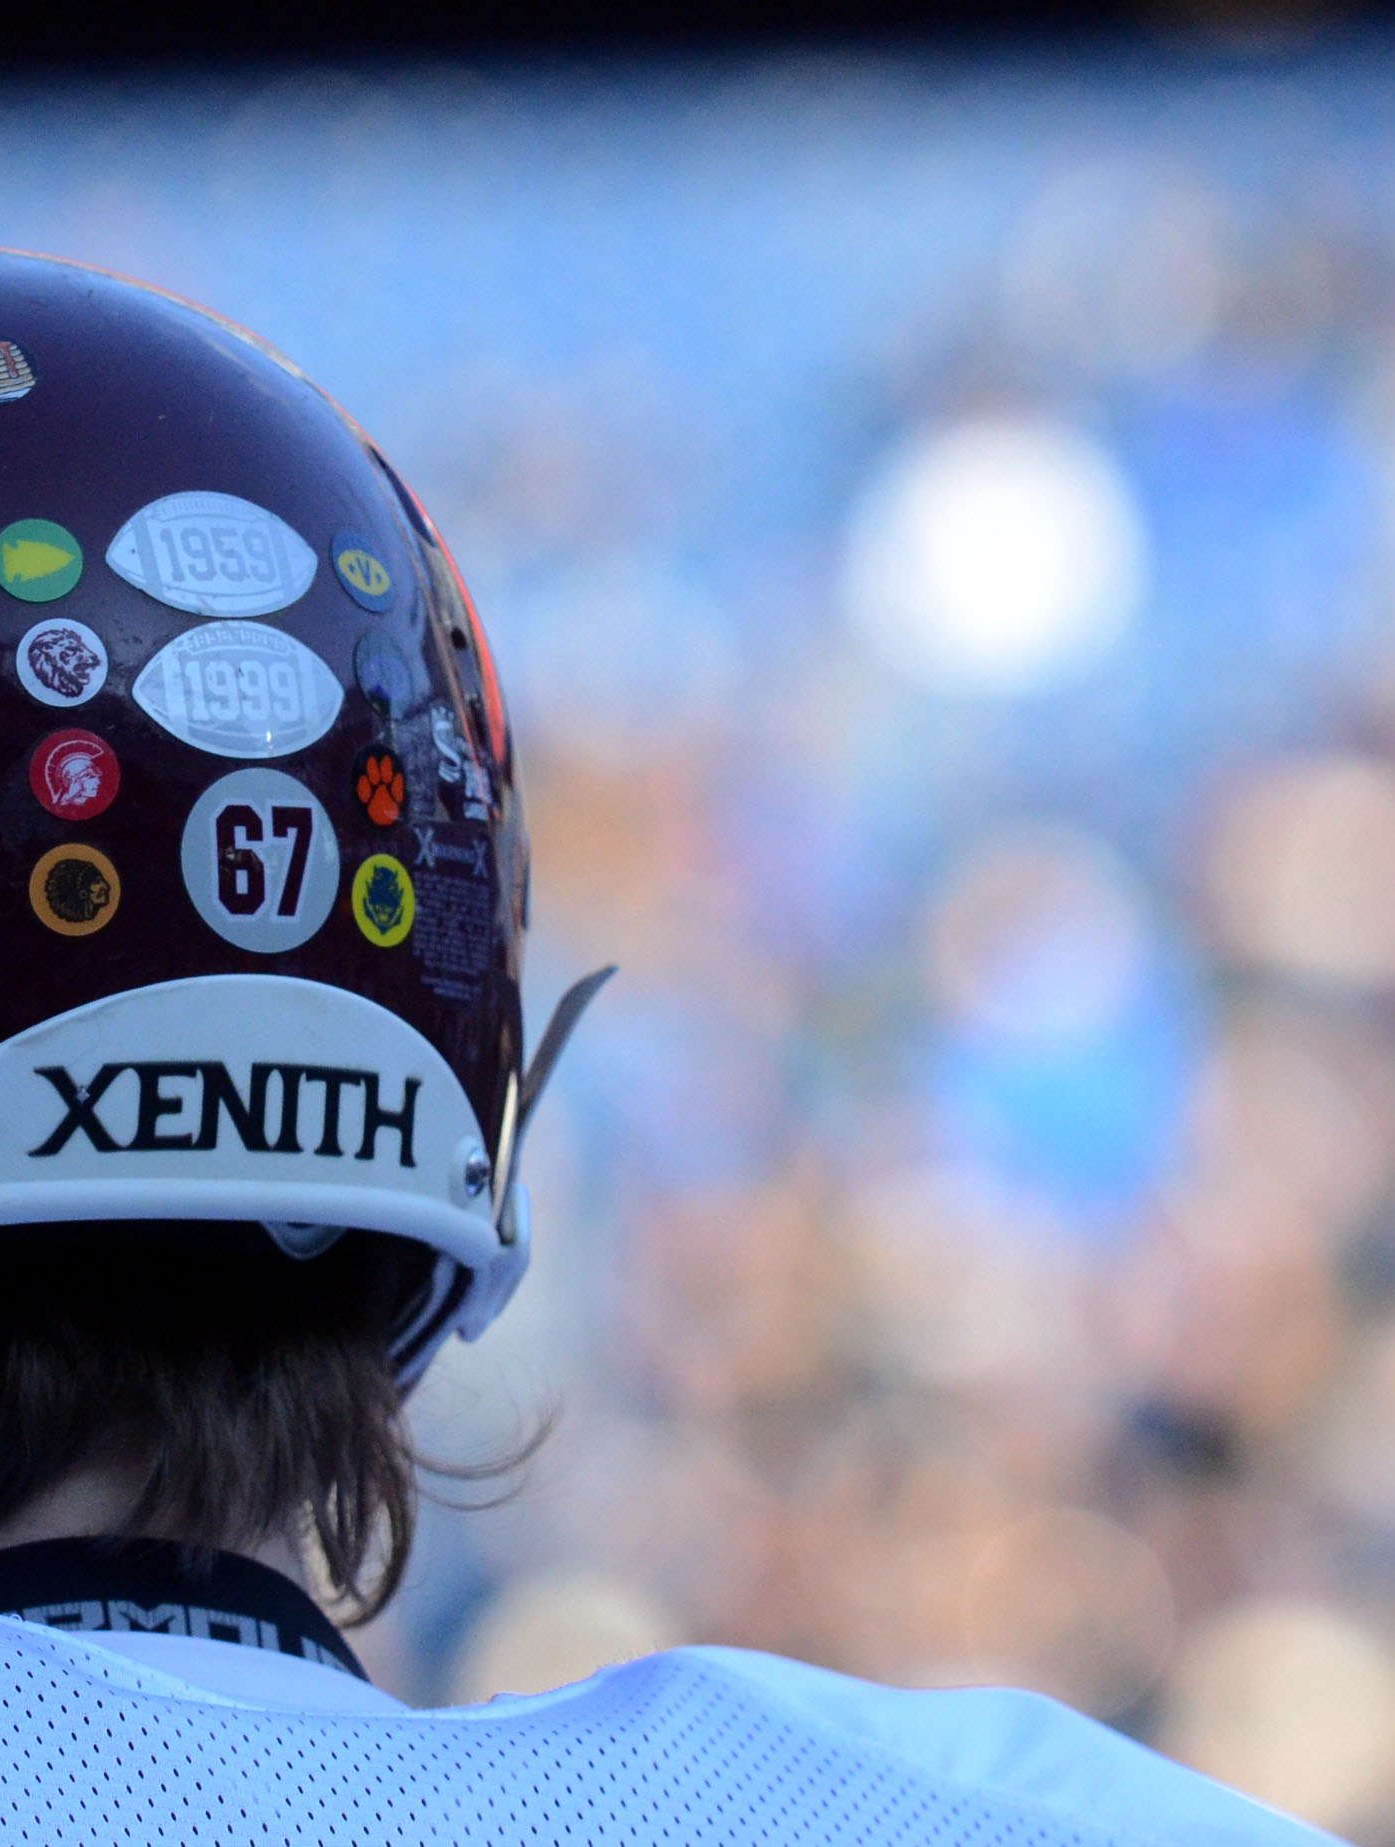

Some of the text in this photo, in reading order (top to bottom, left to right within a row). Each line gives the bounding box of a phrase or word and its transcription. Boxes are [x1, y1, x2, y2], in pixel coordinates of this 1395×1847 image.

[160, 527, 277, 583] 1959
[184, 660, 300, 722] 1999
[215, 804, 313, 917] 67
[27, 1060, 423, 1168] XENITH
